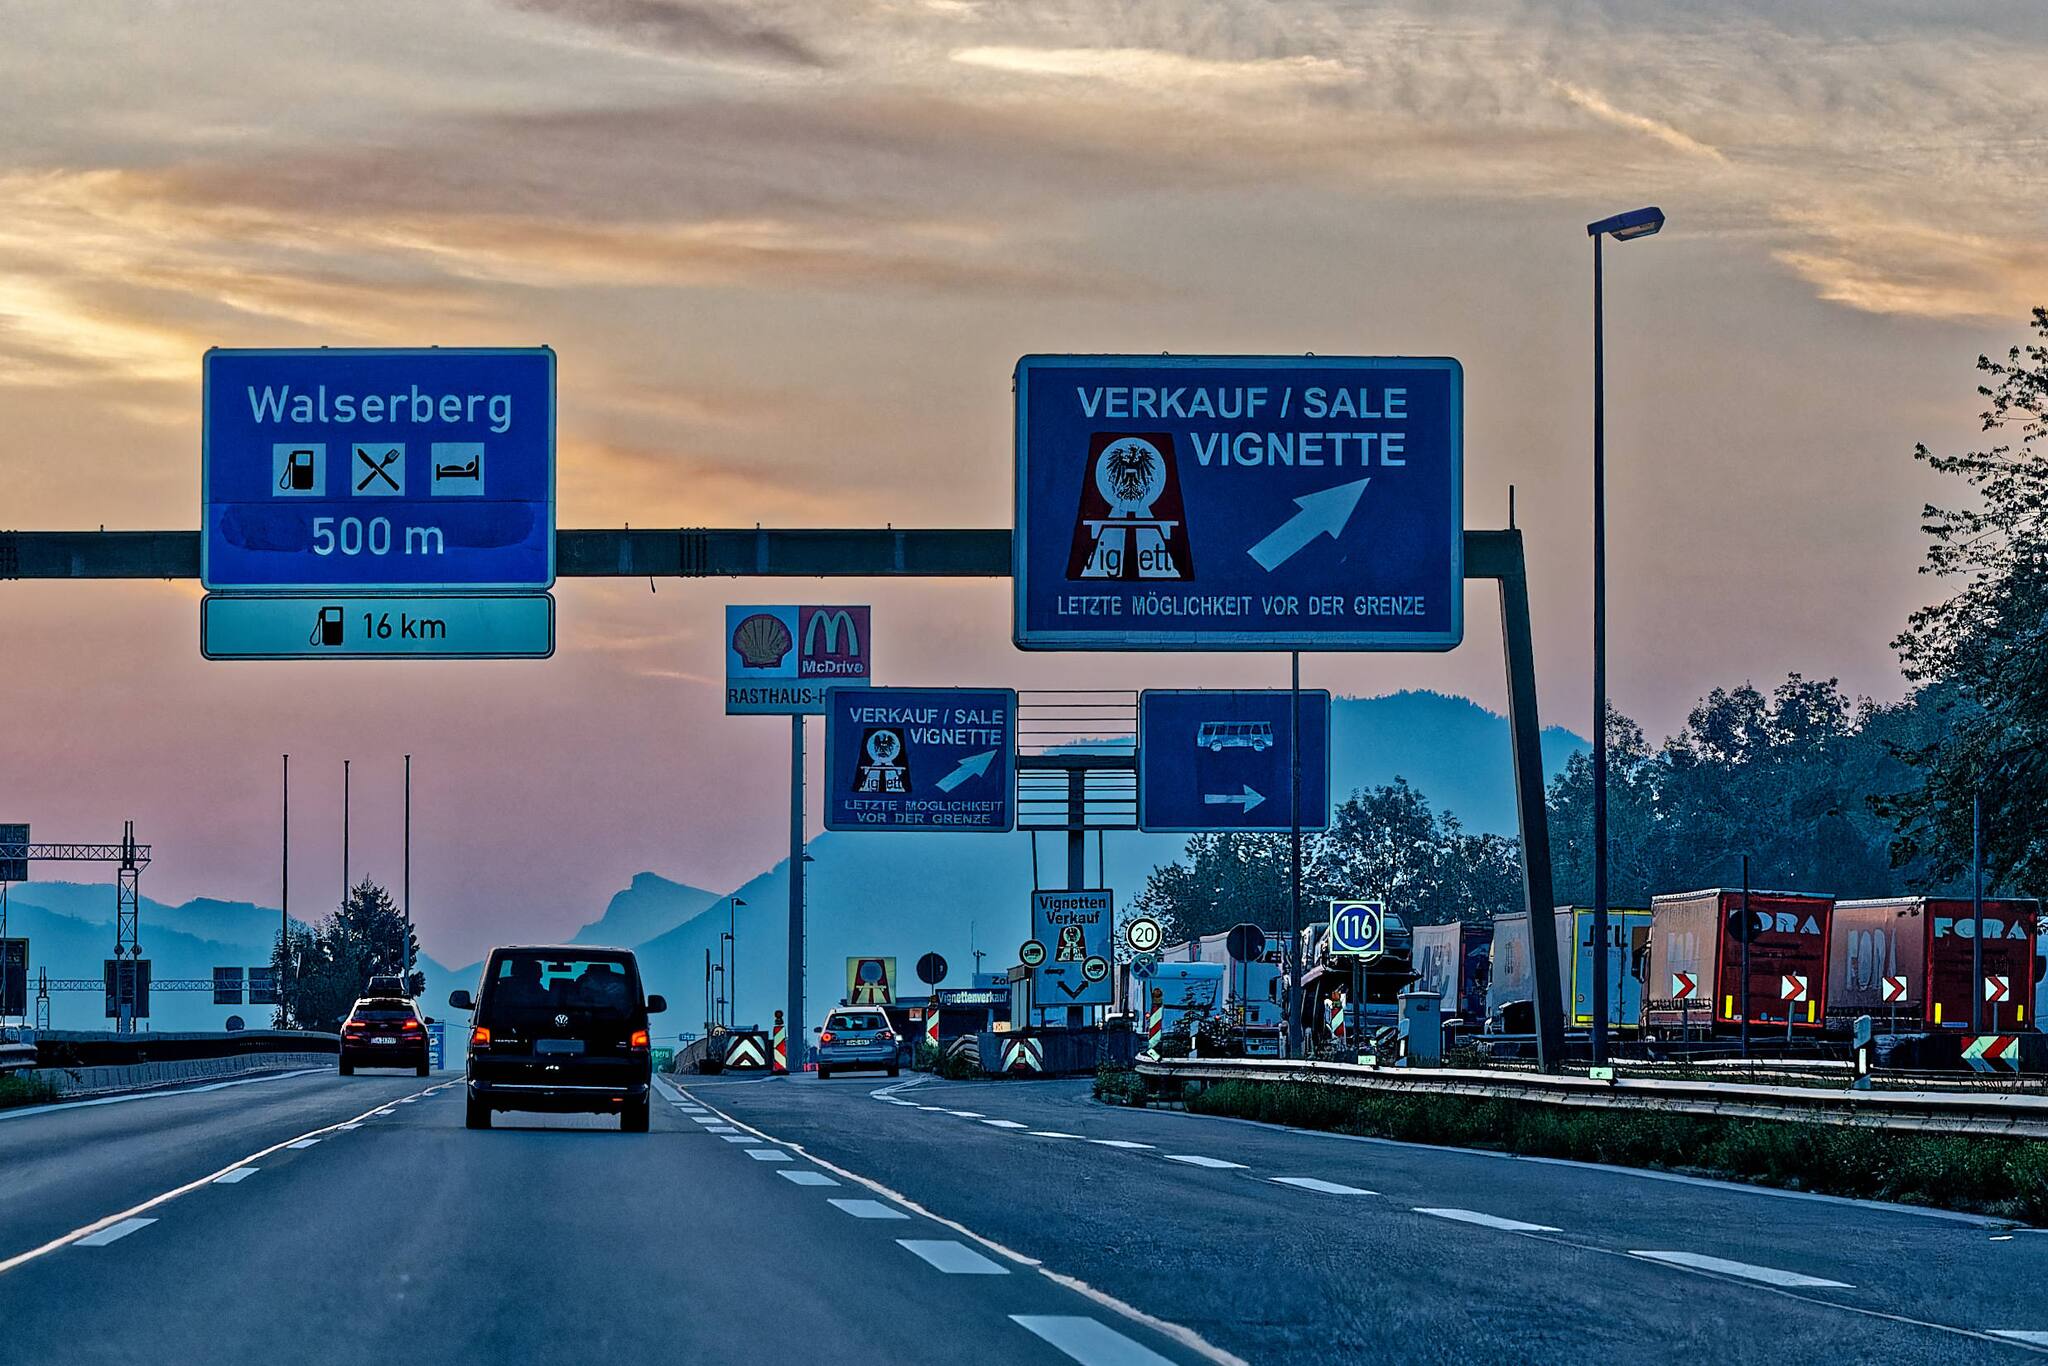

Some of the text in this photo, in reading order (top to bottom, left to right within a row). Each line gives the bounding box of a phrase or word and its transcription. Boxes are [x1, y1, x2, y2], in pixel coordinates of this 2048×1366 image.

[248, 385, 512, 433] Walserberg
[1077, 386, 1408, 419] VERKAUF / SALE
[1190, 432, 1406, 467] VIGNETTE
[313, 517, 444, 555] 500 m
[1058, 591, 1425, 616] LETZTE MÖGLICHKEIT VOR DER GRENZE
[364, 613, 446, 640] 16 km
[802, 659, 864, 673] McDrive
[850, 708, 938, 724] VERKAUF
[954, 709, 1004, 725] SALE
[910, 728, 1002, 745] VIGNETTE
[845, 799, 1004, 812] LETZTE MÖGLICHKEIT
[857, 813, 991, 825] VOR DER GRENZE
[1040, 896, 1107, 912] Vignetten
[1046, 911, 1101, 924] Verkauf
[1135, 927, 1154, 943] 20
[1341, 914, 1372, 940] 116
[939, 990, 1007, 1006] Vignettenverkauf
